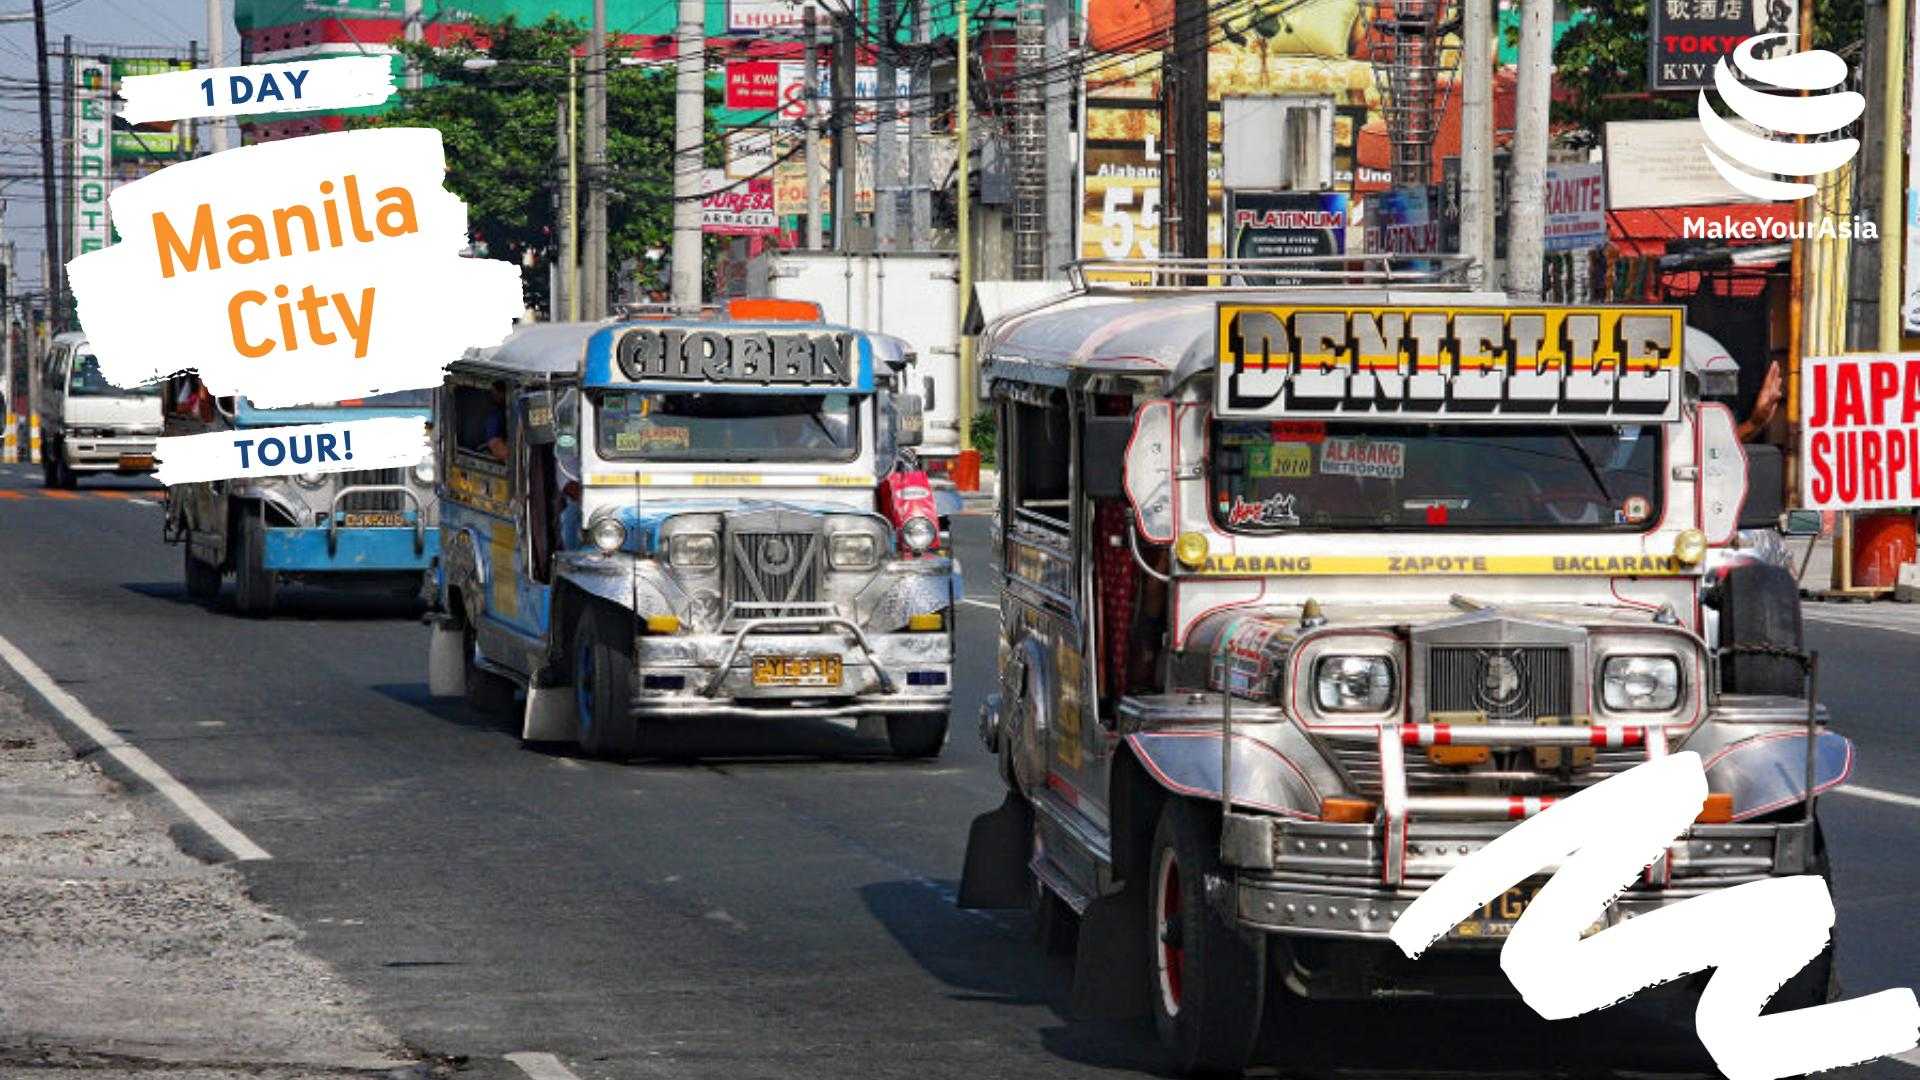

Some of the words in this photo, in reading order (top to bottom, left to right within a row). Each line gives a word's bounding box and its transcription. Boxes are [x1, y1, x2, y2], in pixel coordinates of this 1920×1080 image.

[1664, 64, 1705, 80] KTV
[1097, 163, 1161, 178] Alaban
[1358, 168, 1392, 182] Uno
[703, 213, 773, 225] ARMACIA
[1236, 209, 1343, 230] PLATINUM
[1229, 312, 1673, 415] DENIELLE
[1326, 440, 1400, 464] ALABANG
[1203, 557, 1312, 573] ALABANG
[1388, 557, 1488, 573] ZAPOTE
[1553, 557, 1672, 573] BACLARAN
